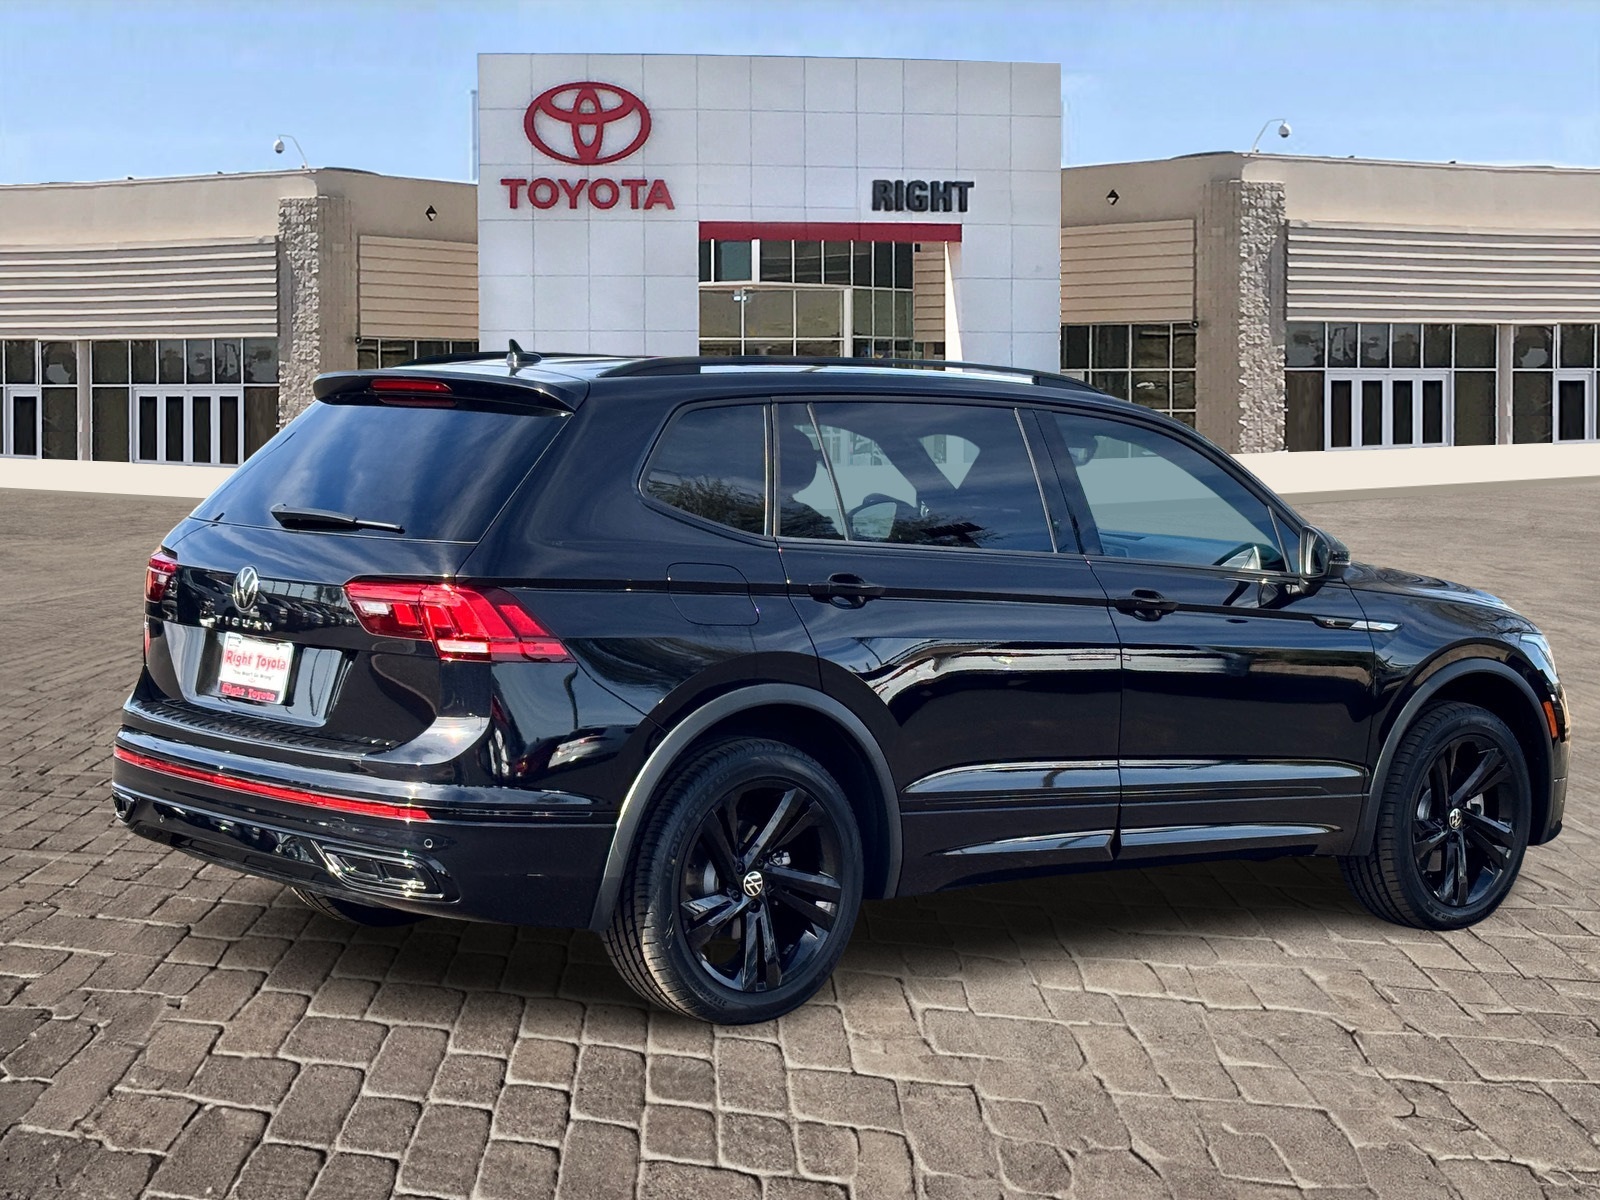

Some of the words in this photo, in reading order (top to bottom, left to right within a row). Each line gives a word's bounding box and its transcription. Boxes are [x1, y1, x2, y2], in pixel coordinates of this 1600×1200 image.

[500, 177, 675, 210] TOYOTA
[871, 179, 975, 212] RIGHT
[225, 650, 253, 667] Right
[255, 654, 287, 671] Toyota
[248, 688, 276, 701] Toyota
